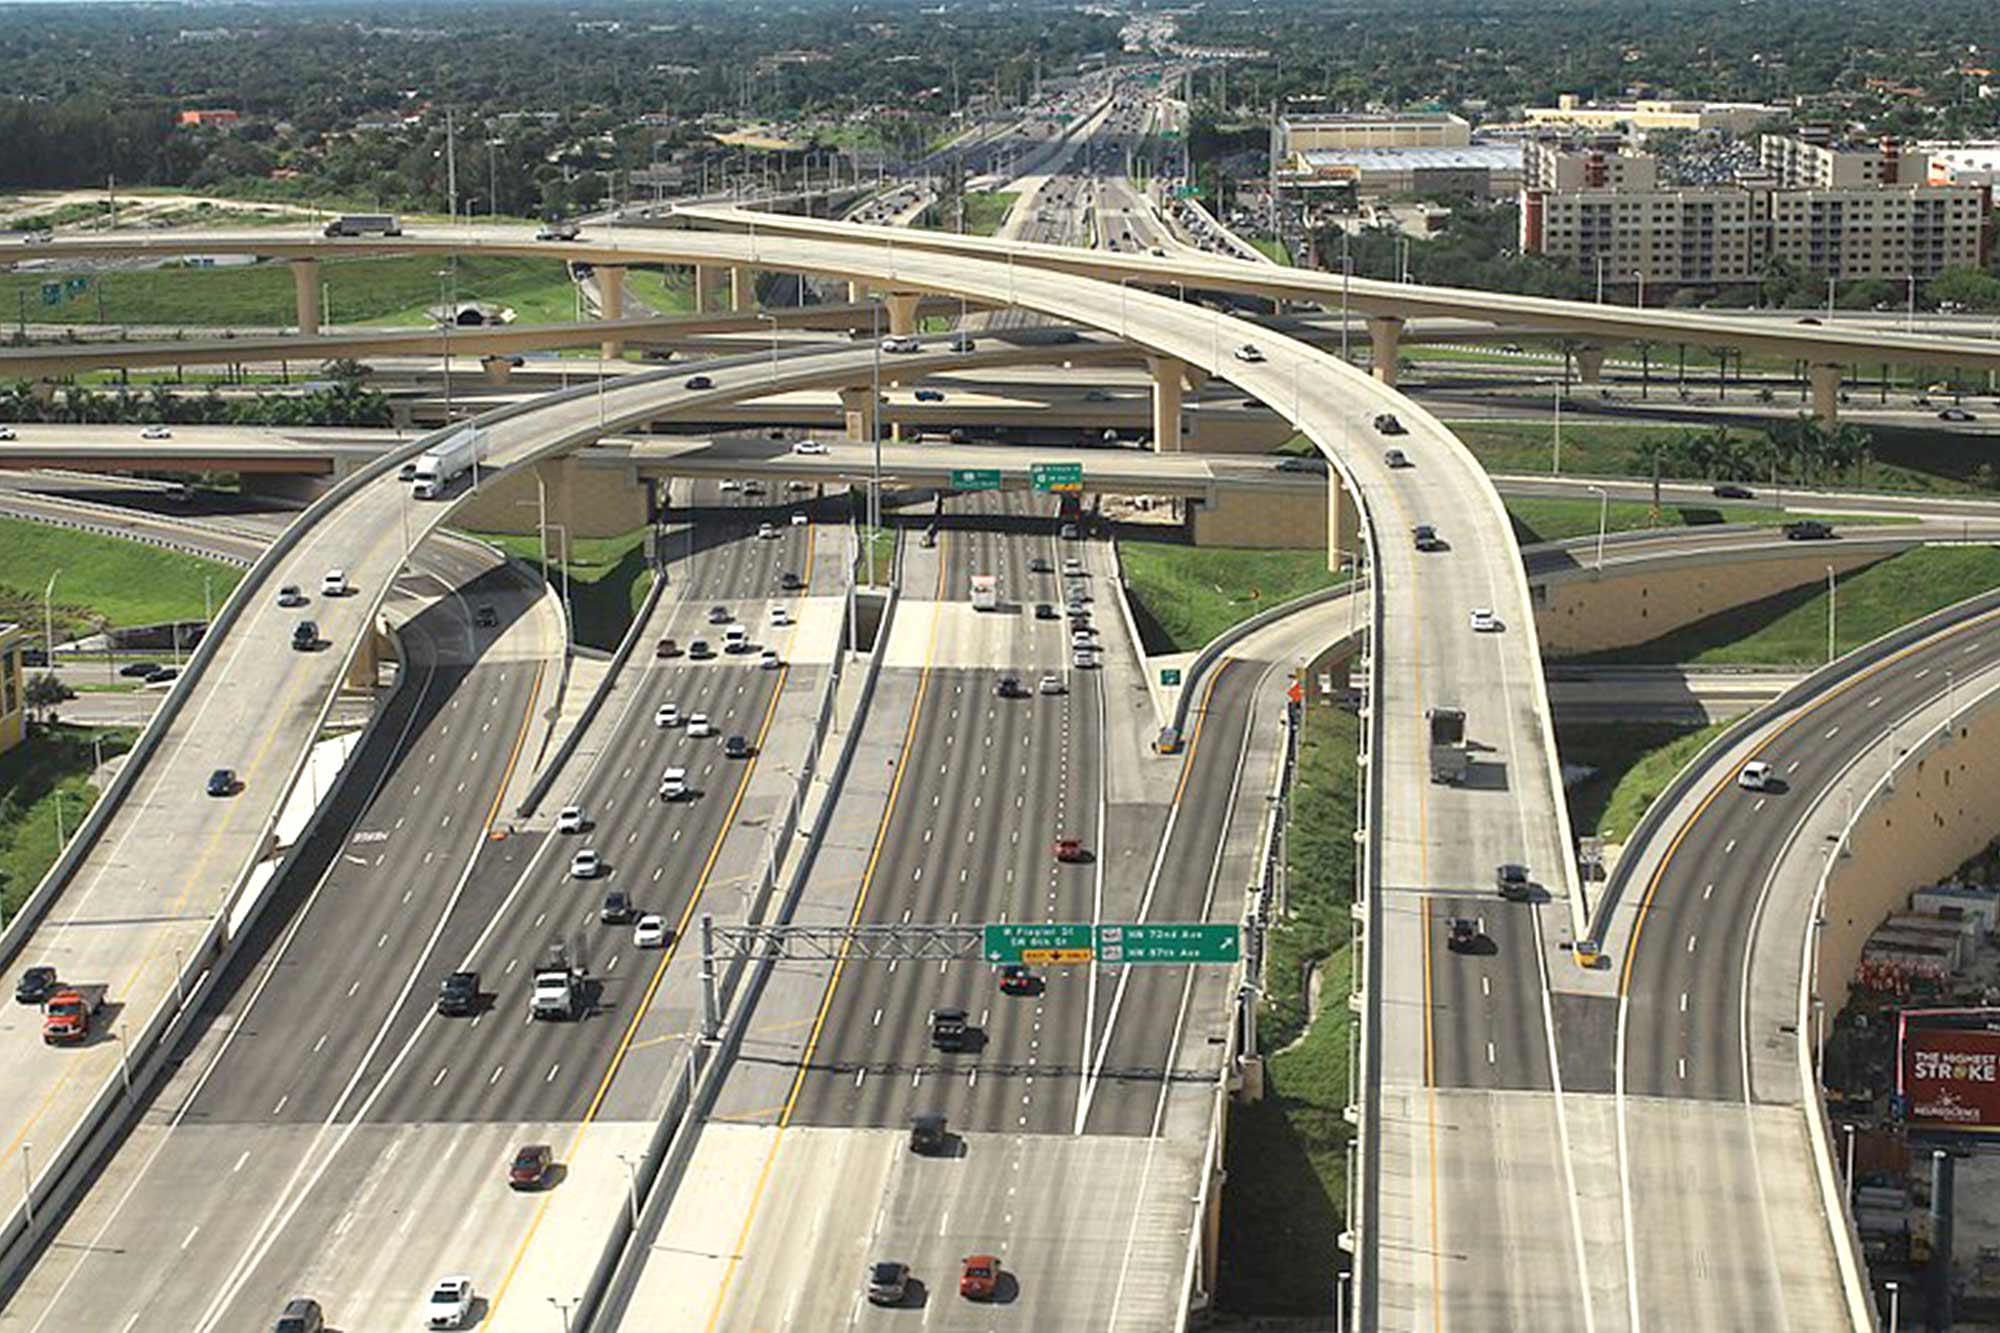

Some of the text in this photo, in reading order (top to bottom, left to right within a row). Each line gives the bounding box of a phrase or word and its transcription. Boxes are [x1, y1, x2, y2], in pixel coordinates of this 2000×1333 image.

[1061, 926, 1075, 937] St
[1149, 929, 1177, 939] 72nd
[1181, 929, 1203, 939] Ave
[1180, 948, 1201, 958] Ave
[1915, 1051, 1996, 1064] THE HIGHEST
[1914, 1062, 1997, 1081] STROKE
